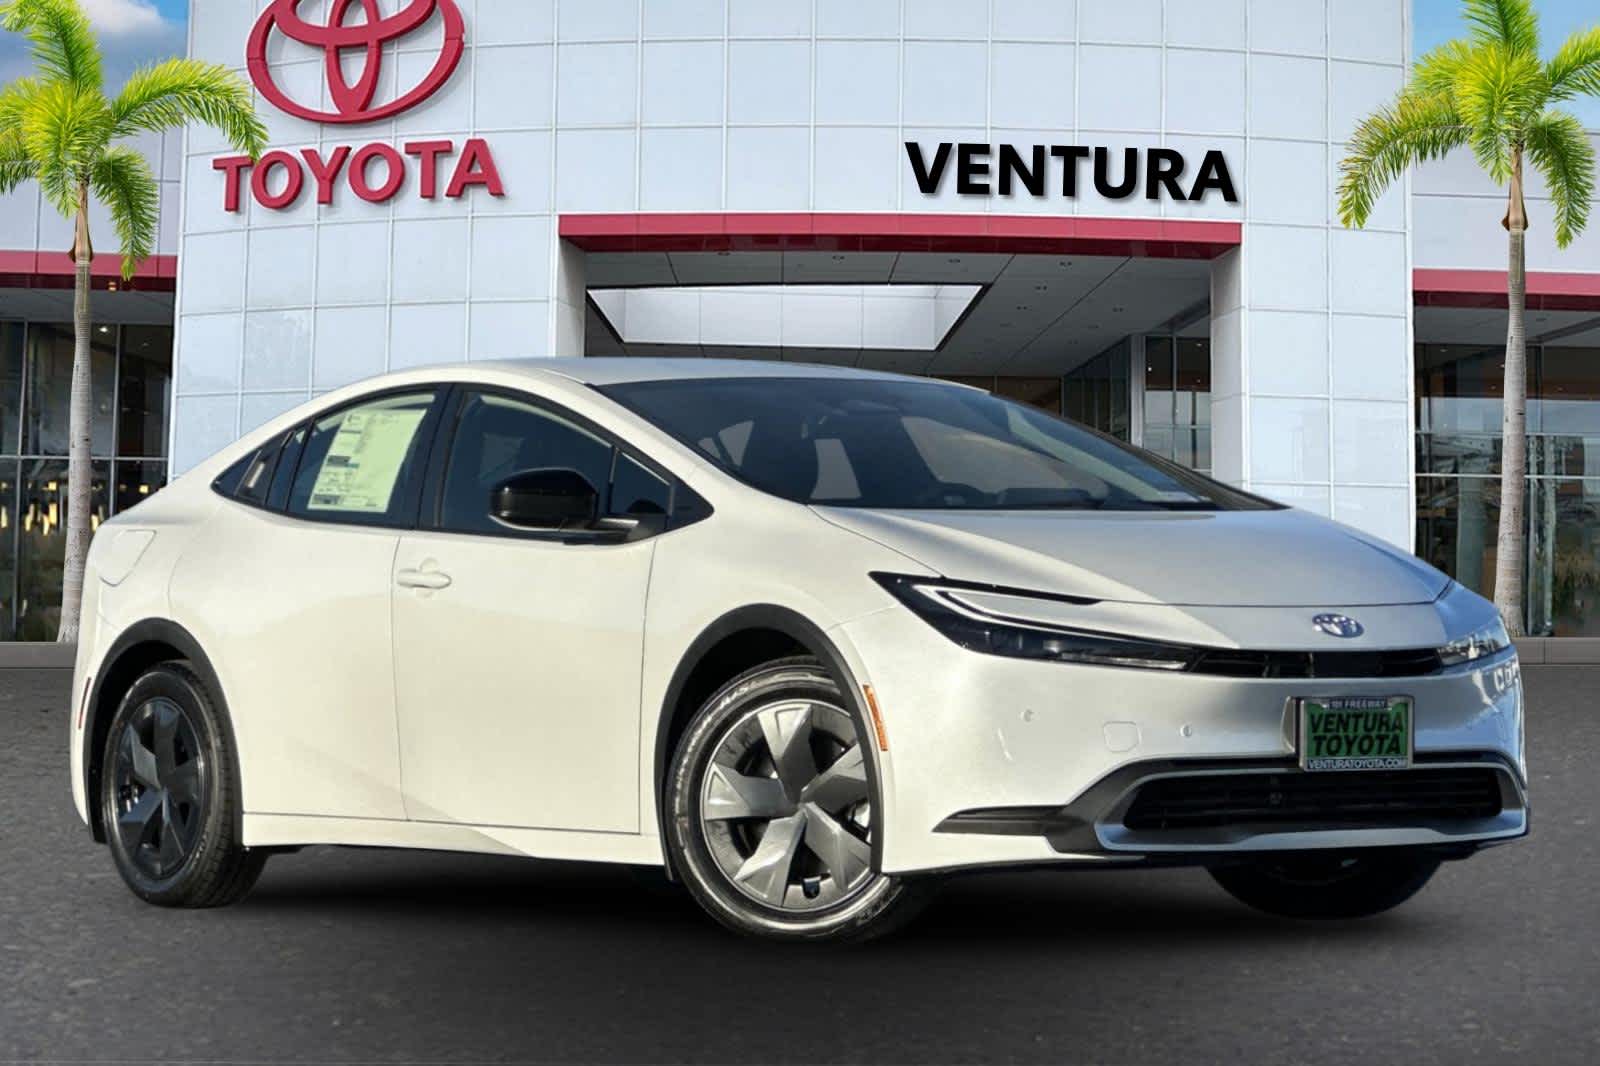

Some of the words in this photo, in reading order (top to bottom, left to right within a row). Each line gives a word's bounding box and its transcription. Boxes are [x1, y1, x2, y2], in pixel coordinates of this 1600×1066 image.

[212, 138, 505, 213] TOYOTA
[904, 142, 1239, 203] VENTURA
[1310, 711, 1404, 733] VENTURA
[1313, 734, 1401, 756] TOYOTA
